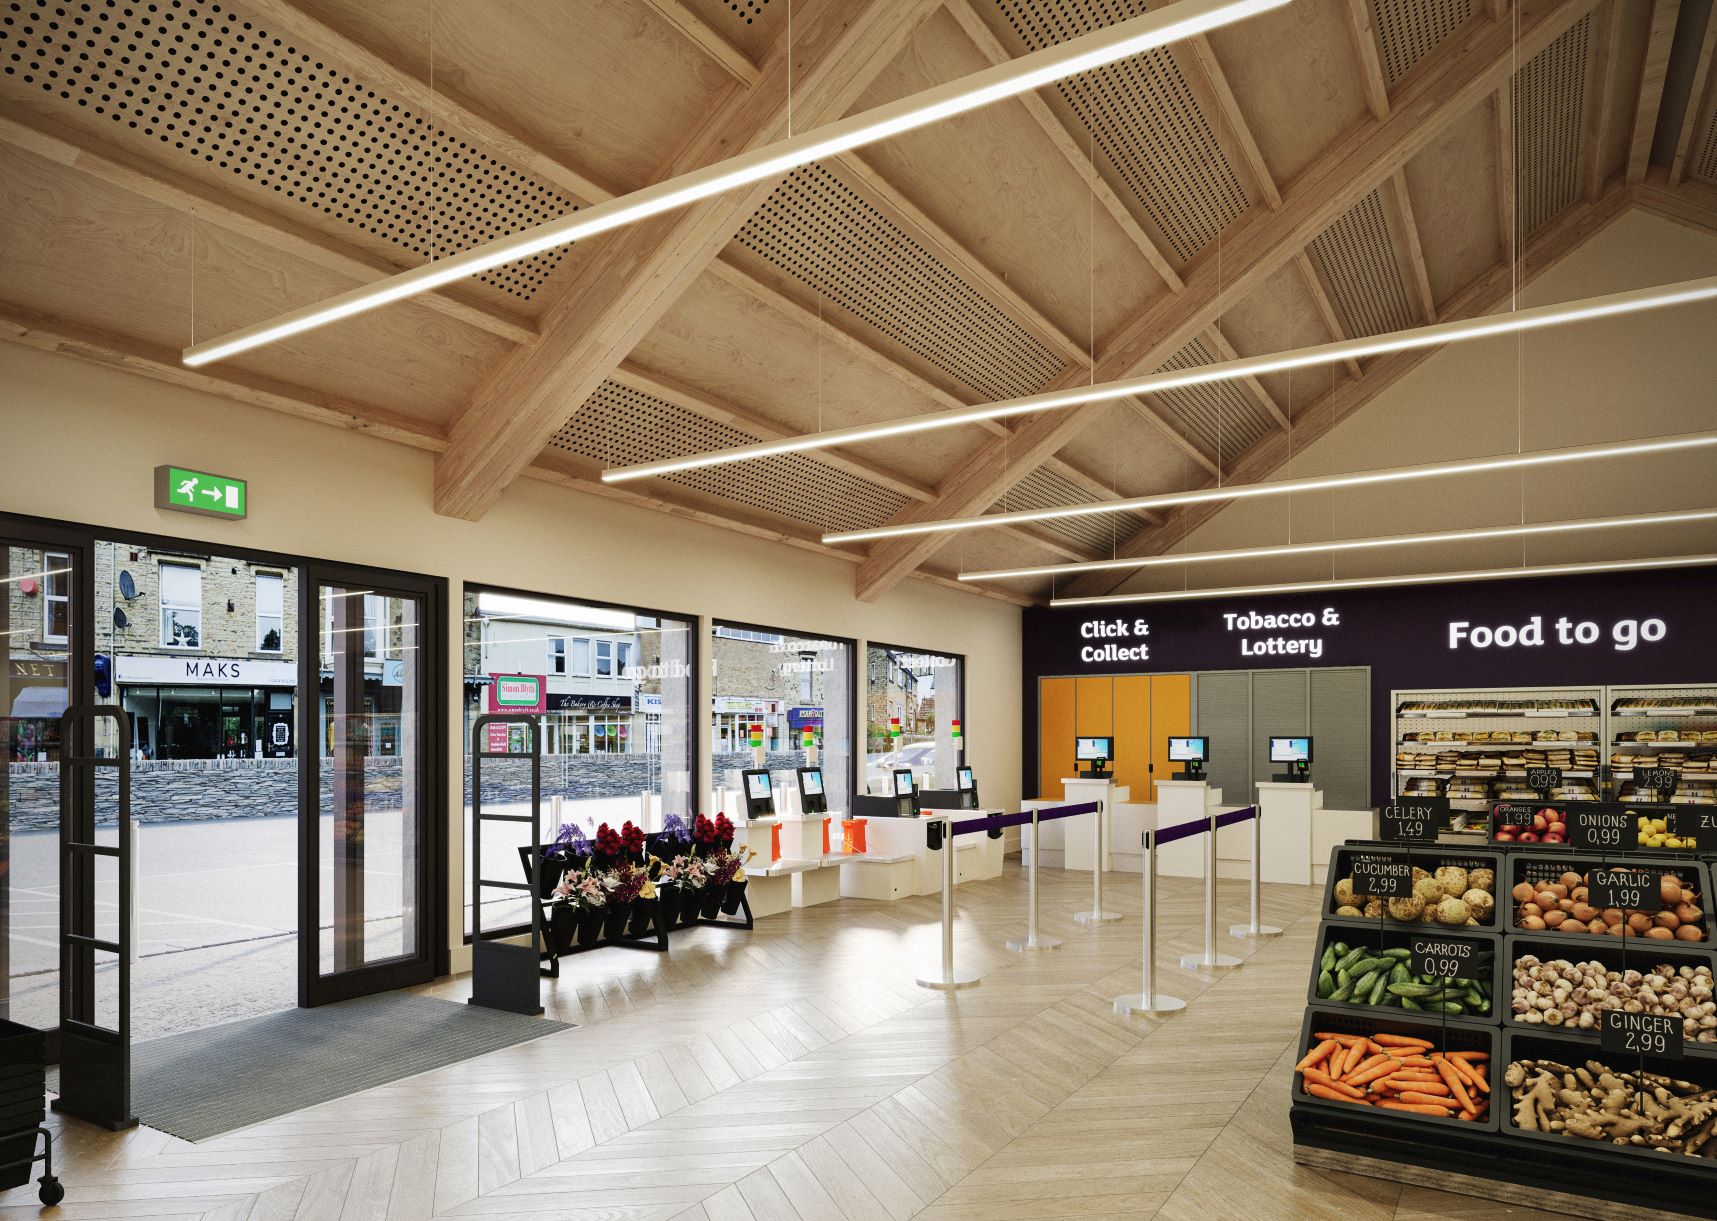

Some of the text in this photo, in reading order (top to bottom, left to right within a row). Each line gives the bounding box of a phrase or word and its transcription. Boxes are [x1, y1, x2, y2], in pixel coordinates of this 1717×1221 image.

[1081, 618, 1150, 638] Click &
[1223, 608, 1340, 631] Tobacco &
[1449, 615, 1667, 651] Food to go
[1081, 643, 1149, 663] Collect
[1241, 636, 1323, 658] Lottery
[15, 663, 55, 677] NET
[186, 662, 240, 678] MAKS
[1642, 769, 1675, 777] LEMONS
[1385, 806, 1432, 820] CELERY
[1579, 814, 1628, 828] ONIONS
[1398, 821, 1423, 837] 1,49
[1587, 828, 1620, 845] 0,99
[1354, 862, 1410, 877] CUCUMBER
[1369, 877, 1397, 894] 2,99
[1596, 872, 1650, 887] GARLIC
[1608, 889, 1640, 908] 1,99
[1415, 942, 1471, 958] CARROTS
[1424, 957, 1459, 977] 0,99
[1610, 1013, 1674, 1034] GINGER
[1625, 1031, 1665, 1053] 2,99
